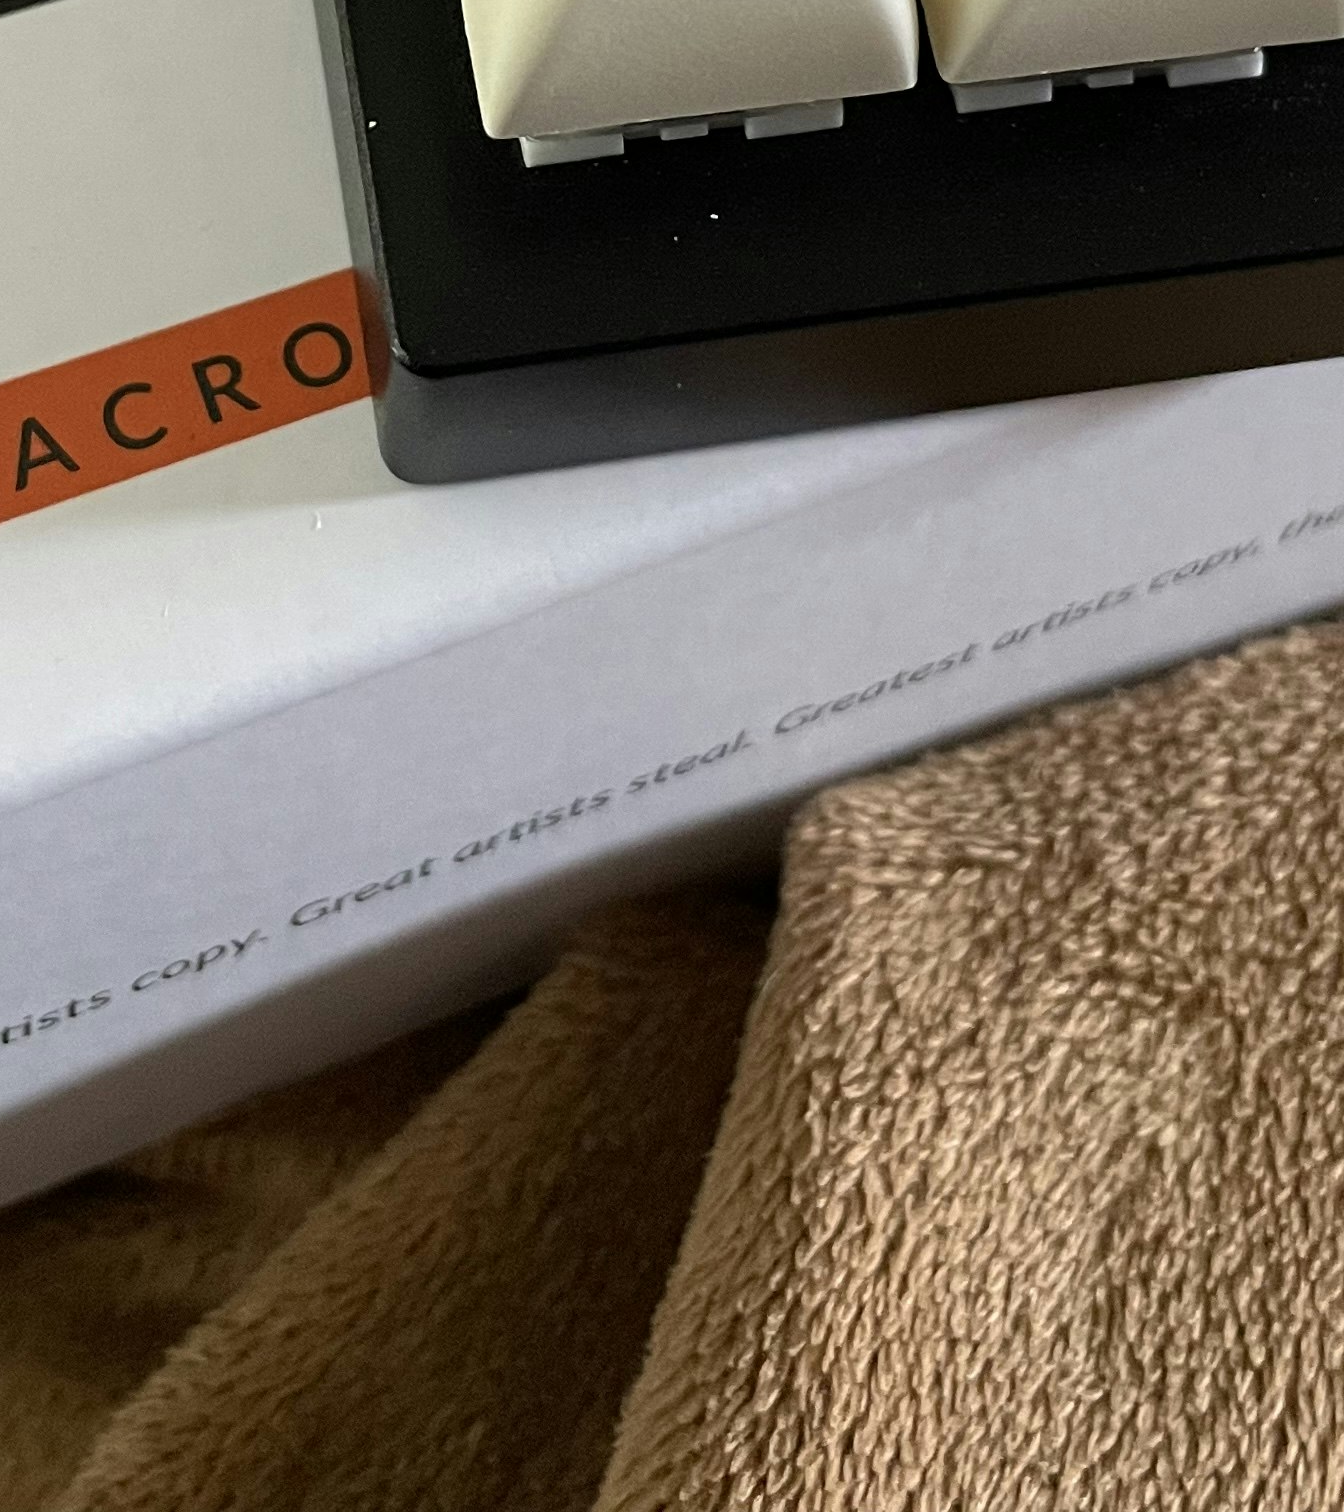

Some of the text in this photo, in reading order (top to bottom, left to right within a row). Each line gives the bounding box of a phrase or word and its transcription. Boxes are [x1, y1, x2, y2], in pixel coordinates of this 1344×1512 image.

[131, 926, 269, 994] copy.
[290, 856, 438, 926] Great
[453, 788, 613, 862] artists
[624, 728, 753, 794] steal.
[774, 642, 982, 734] Greatest
[990, 583, 1140, 652] artists
